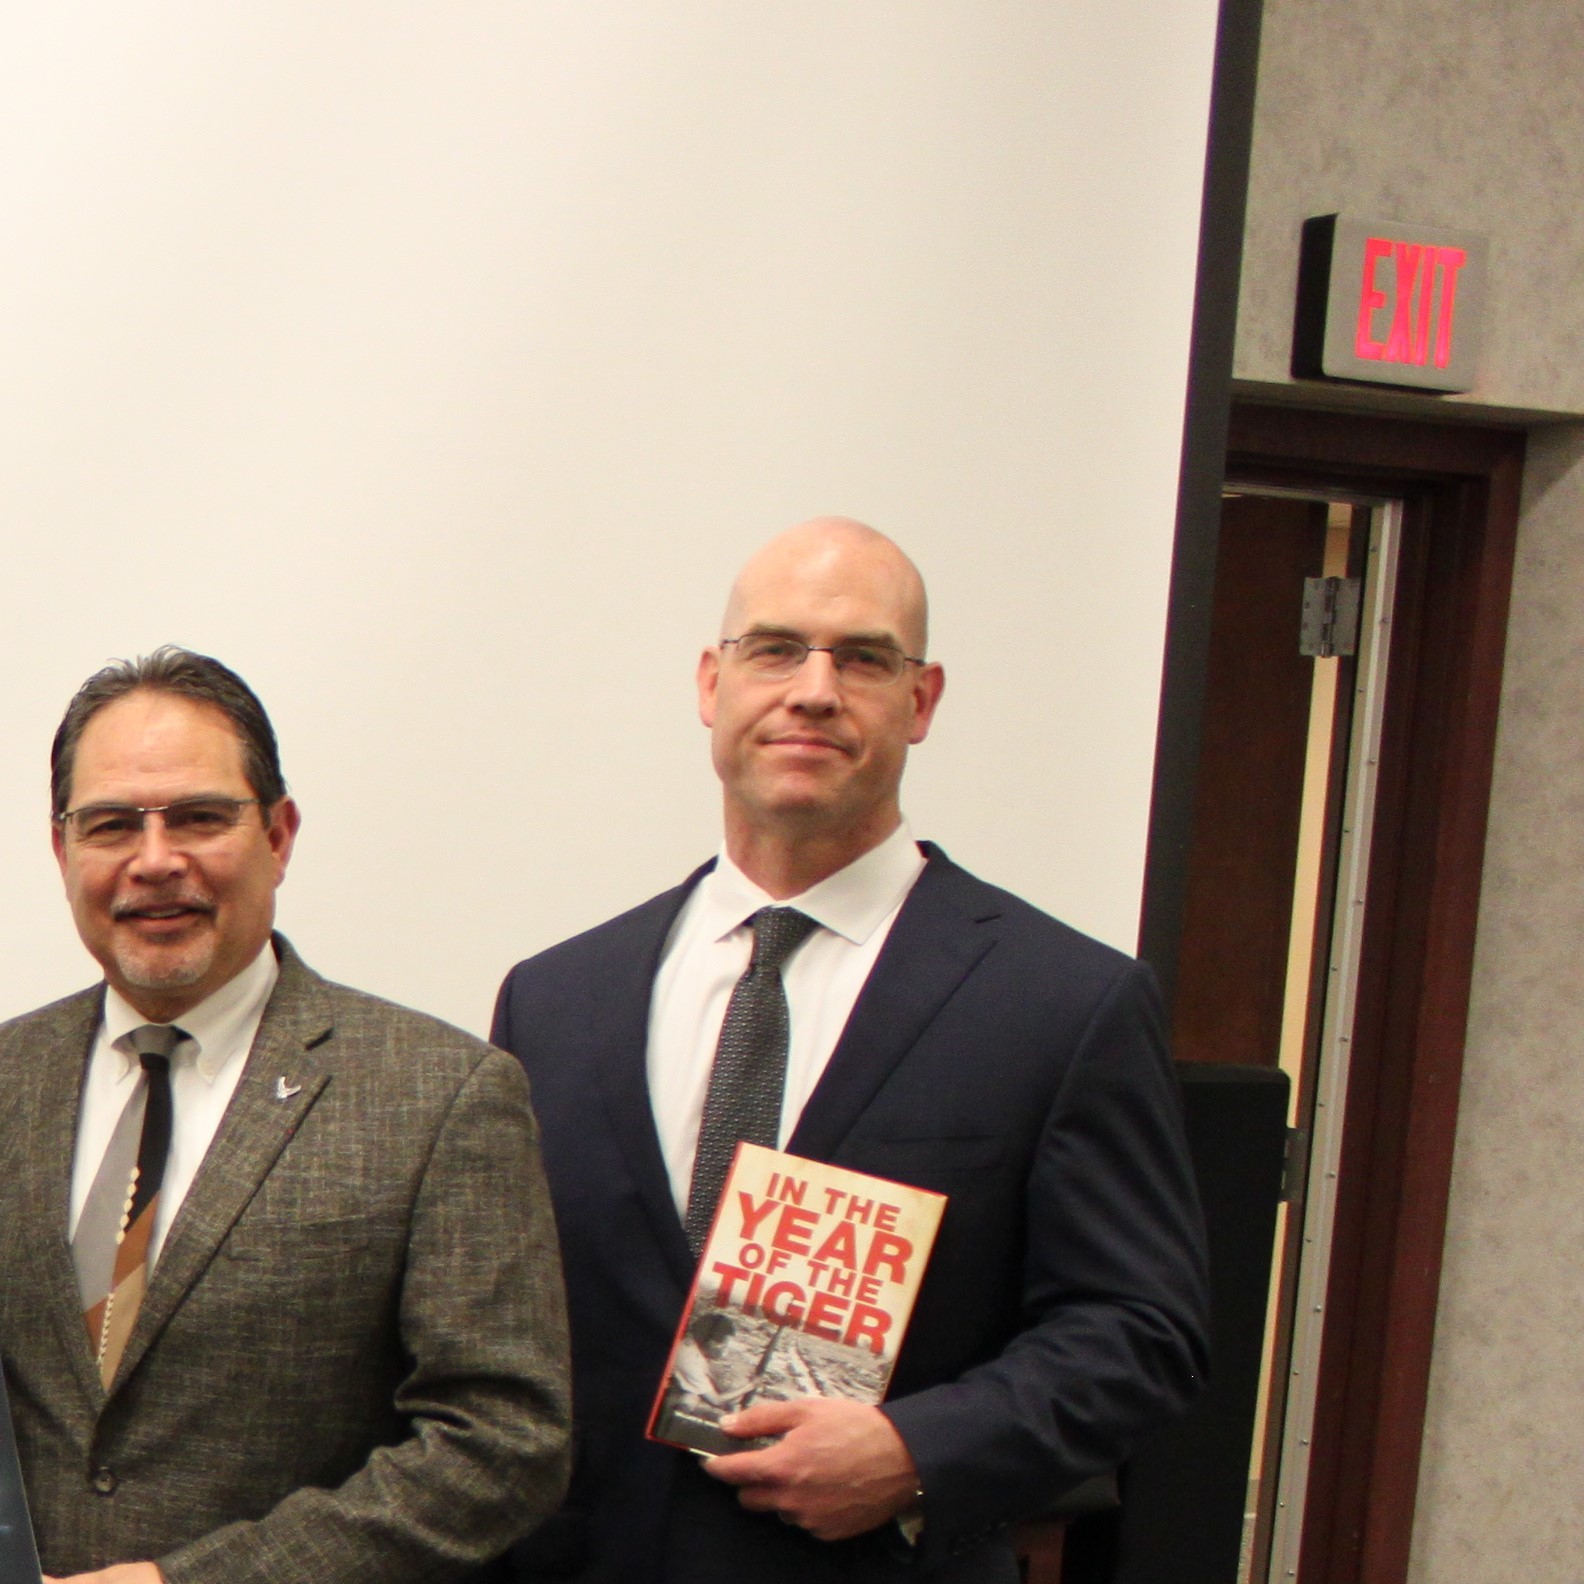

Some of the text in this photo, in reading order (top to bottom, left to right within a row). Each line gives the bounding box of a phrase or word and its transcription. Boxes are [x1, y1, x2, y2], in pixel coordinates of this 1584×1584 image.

[1354, 236, 1468, 369] EXIT
[738, 1191, 914, 1286] YEAR
[766, 1172, 902, 1232] IN THE
[711, 1261, 894, 1355] TIGER
[738, 1243, 884, 1305] OF THE
